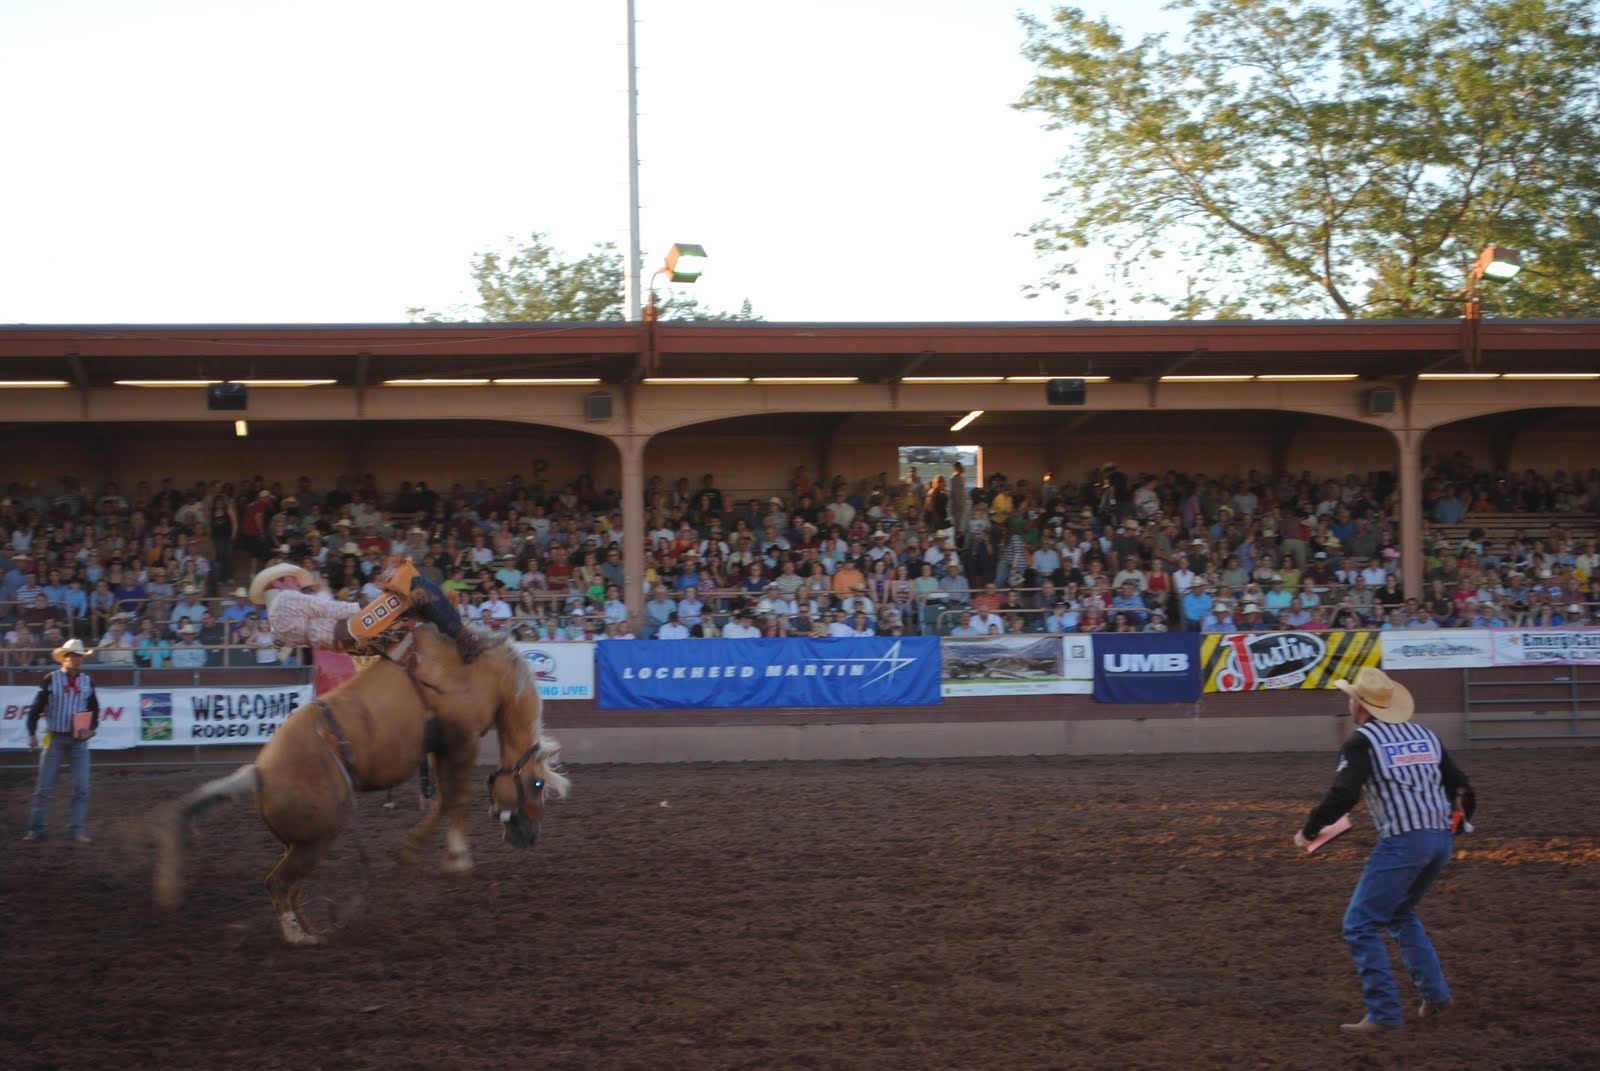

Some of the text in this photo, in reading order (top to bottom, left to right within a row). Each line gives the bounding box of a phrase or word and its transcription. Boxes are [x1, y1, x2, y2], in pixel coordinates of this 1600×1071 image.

[623, 664, 865, 679] LOCKHEED MARTIN
[1103, 653, 1189, 673] UMB
[1217, 633, 1317, 691] Justin
[1265, 672, 1302, 688] BOOTS
[192, 692, 300, 721] WELCOME
[192, 722, 281, 738] RODEO FA
[1384, 741, 1430, 765] prca
